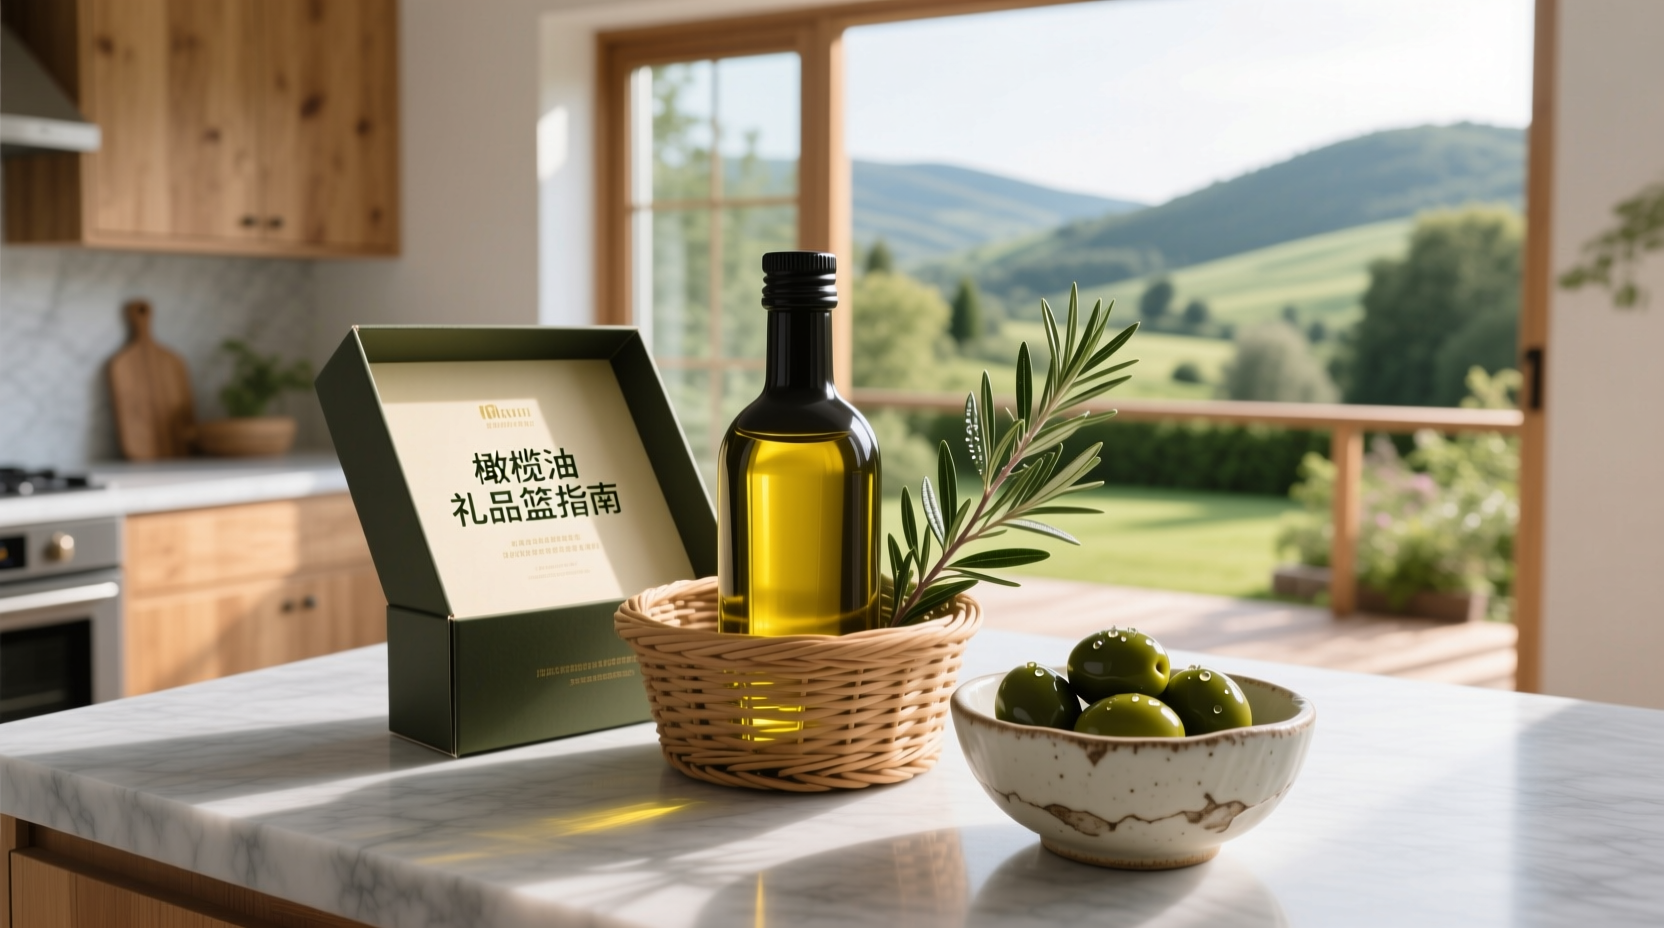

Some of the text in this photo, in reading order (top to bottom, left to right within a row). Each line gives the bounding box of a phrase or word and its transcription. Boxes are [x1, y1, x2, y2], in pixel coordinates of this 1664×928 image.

[472, 448, 579, 485] 橄榄油
[450, 482, 622, 527] 礼品篮指南
